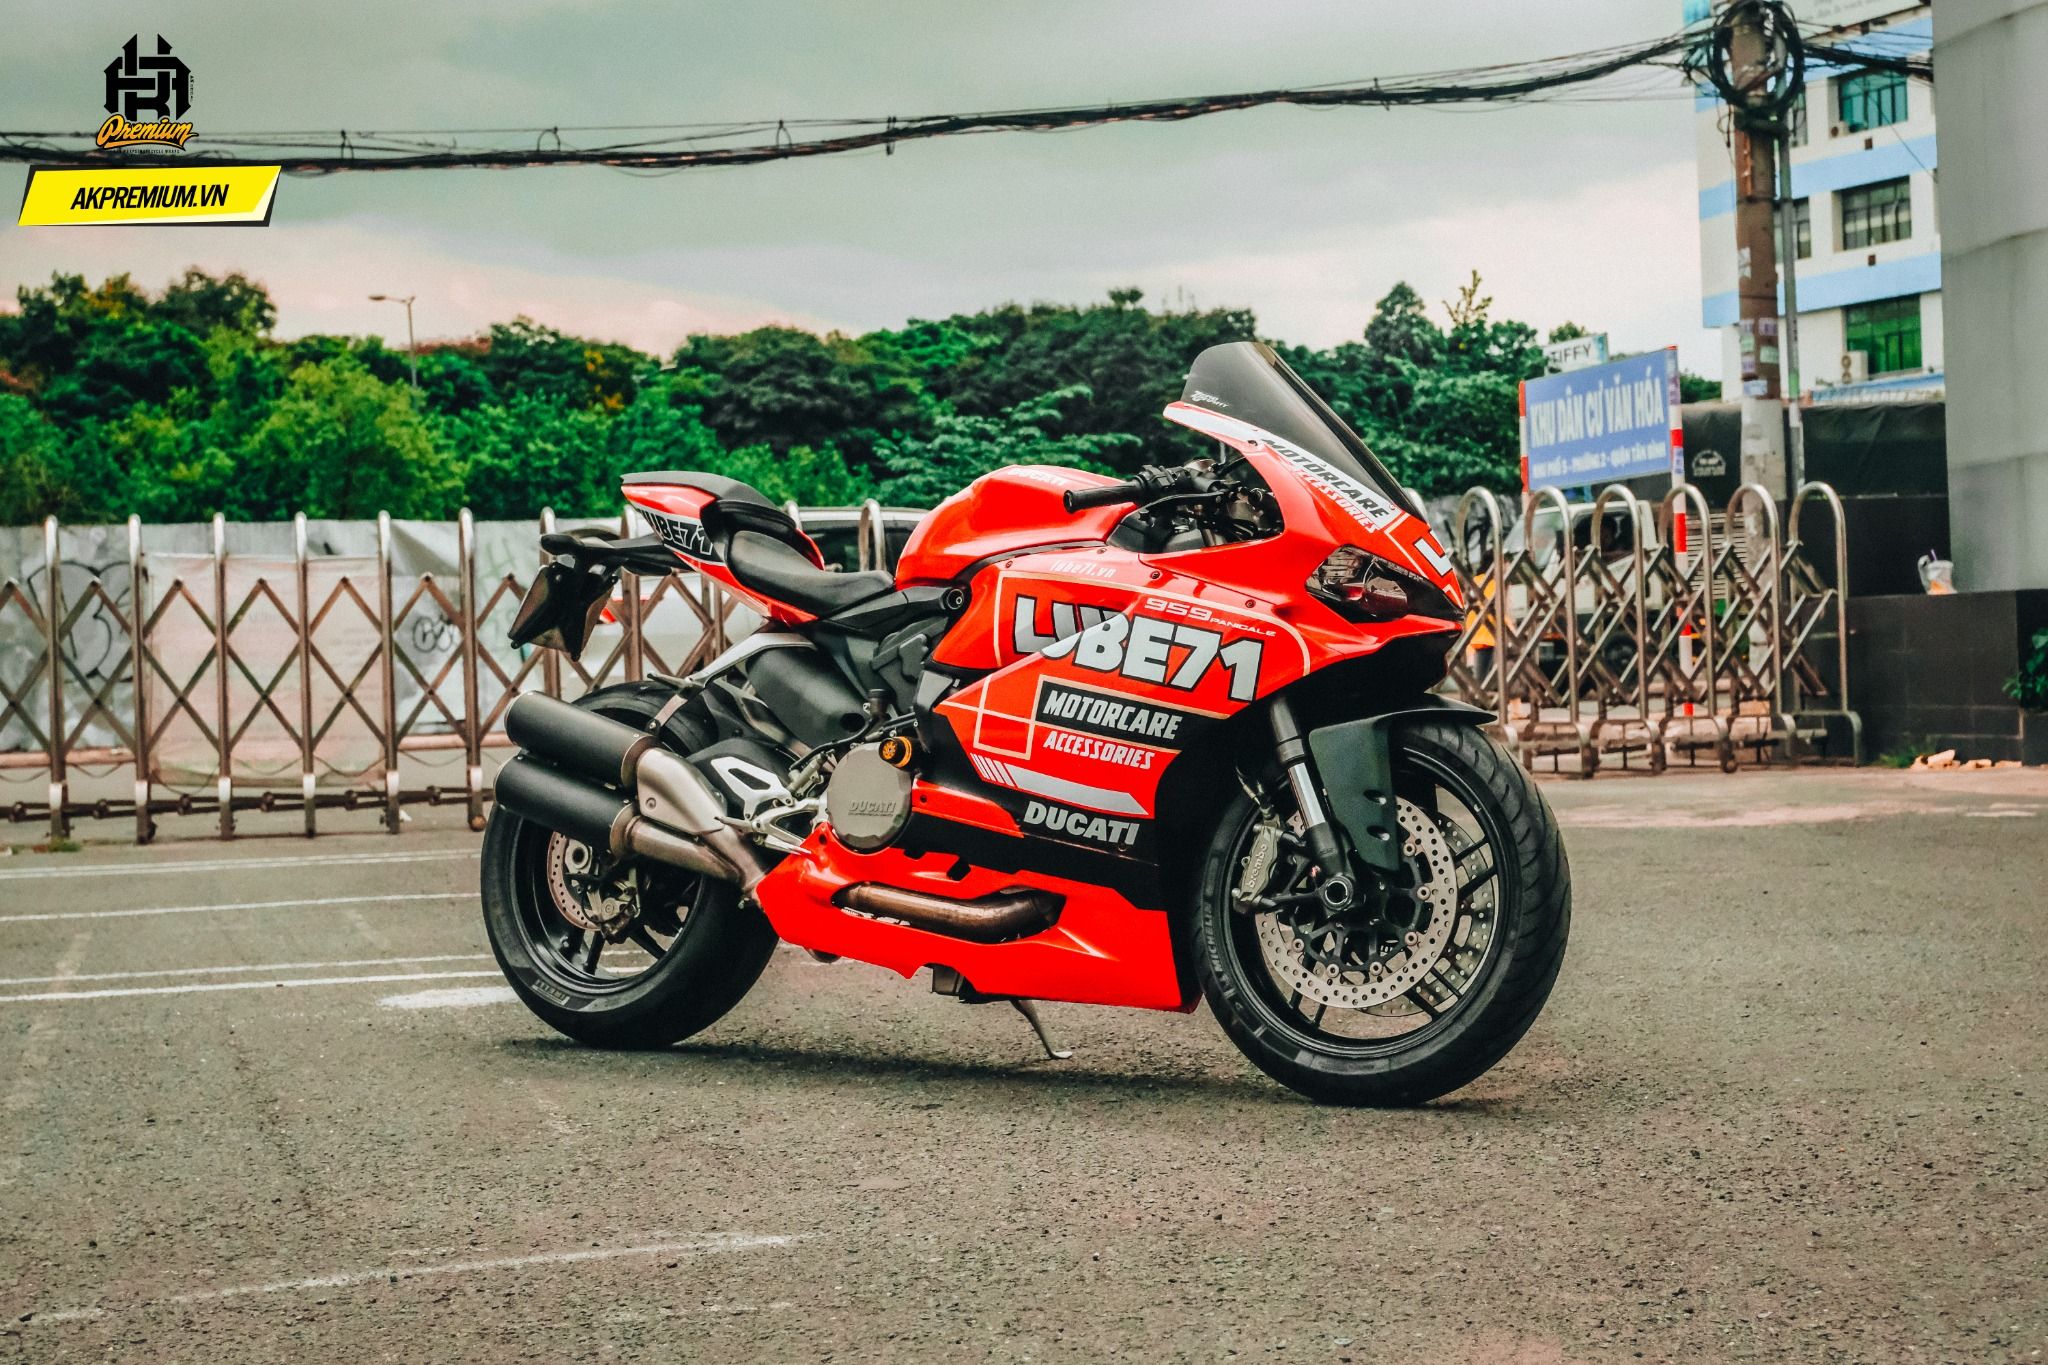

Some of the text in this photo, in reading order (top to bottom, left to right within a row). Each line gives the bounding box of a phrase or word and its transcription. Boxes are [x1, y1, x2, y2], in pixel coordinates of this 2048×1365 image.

[1530, 399, 1556, 449] KHU
[1556, 384, 1585, 444] DÂN
[1605, 373, 1633, 434] VĂN
[1633, 366, 1665, 429] HÓA
[1260, 438, 1390, 519] MOTORCARE
[1144, 597, 1278, 637] 959 PANIGALE
[1013, 593, 1264, 702] LUBE71
[1042, 689, 1183, 740] MOTORCARE
[1042, 730, 1156, 770] ACCESSORIES
[848, 800, 897, 814] DUCATI
[1023, 800, 1141, 846] DUCATI
[1245, 843, 1268, 888] brembo
[1203, 901, 1223, 972] MICHELIN
